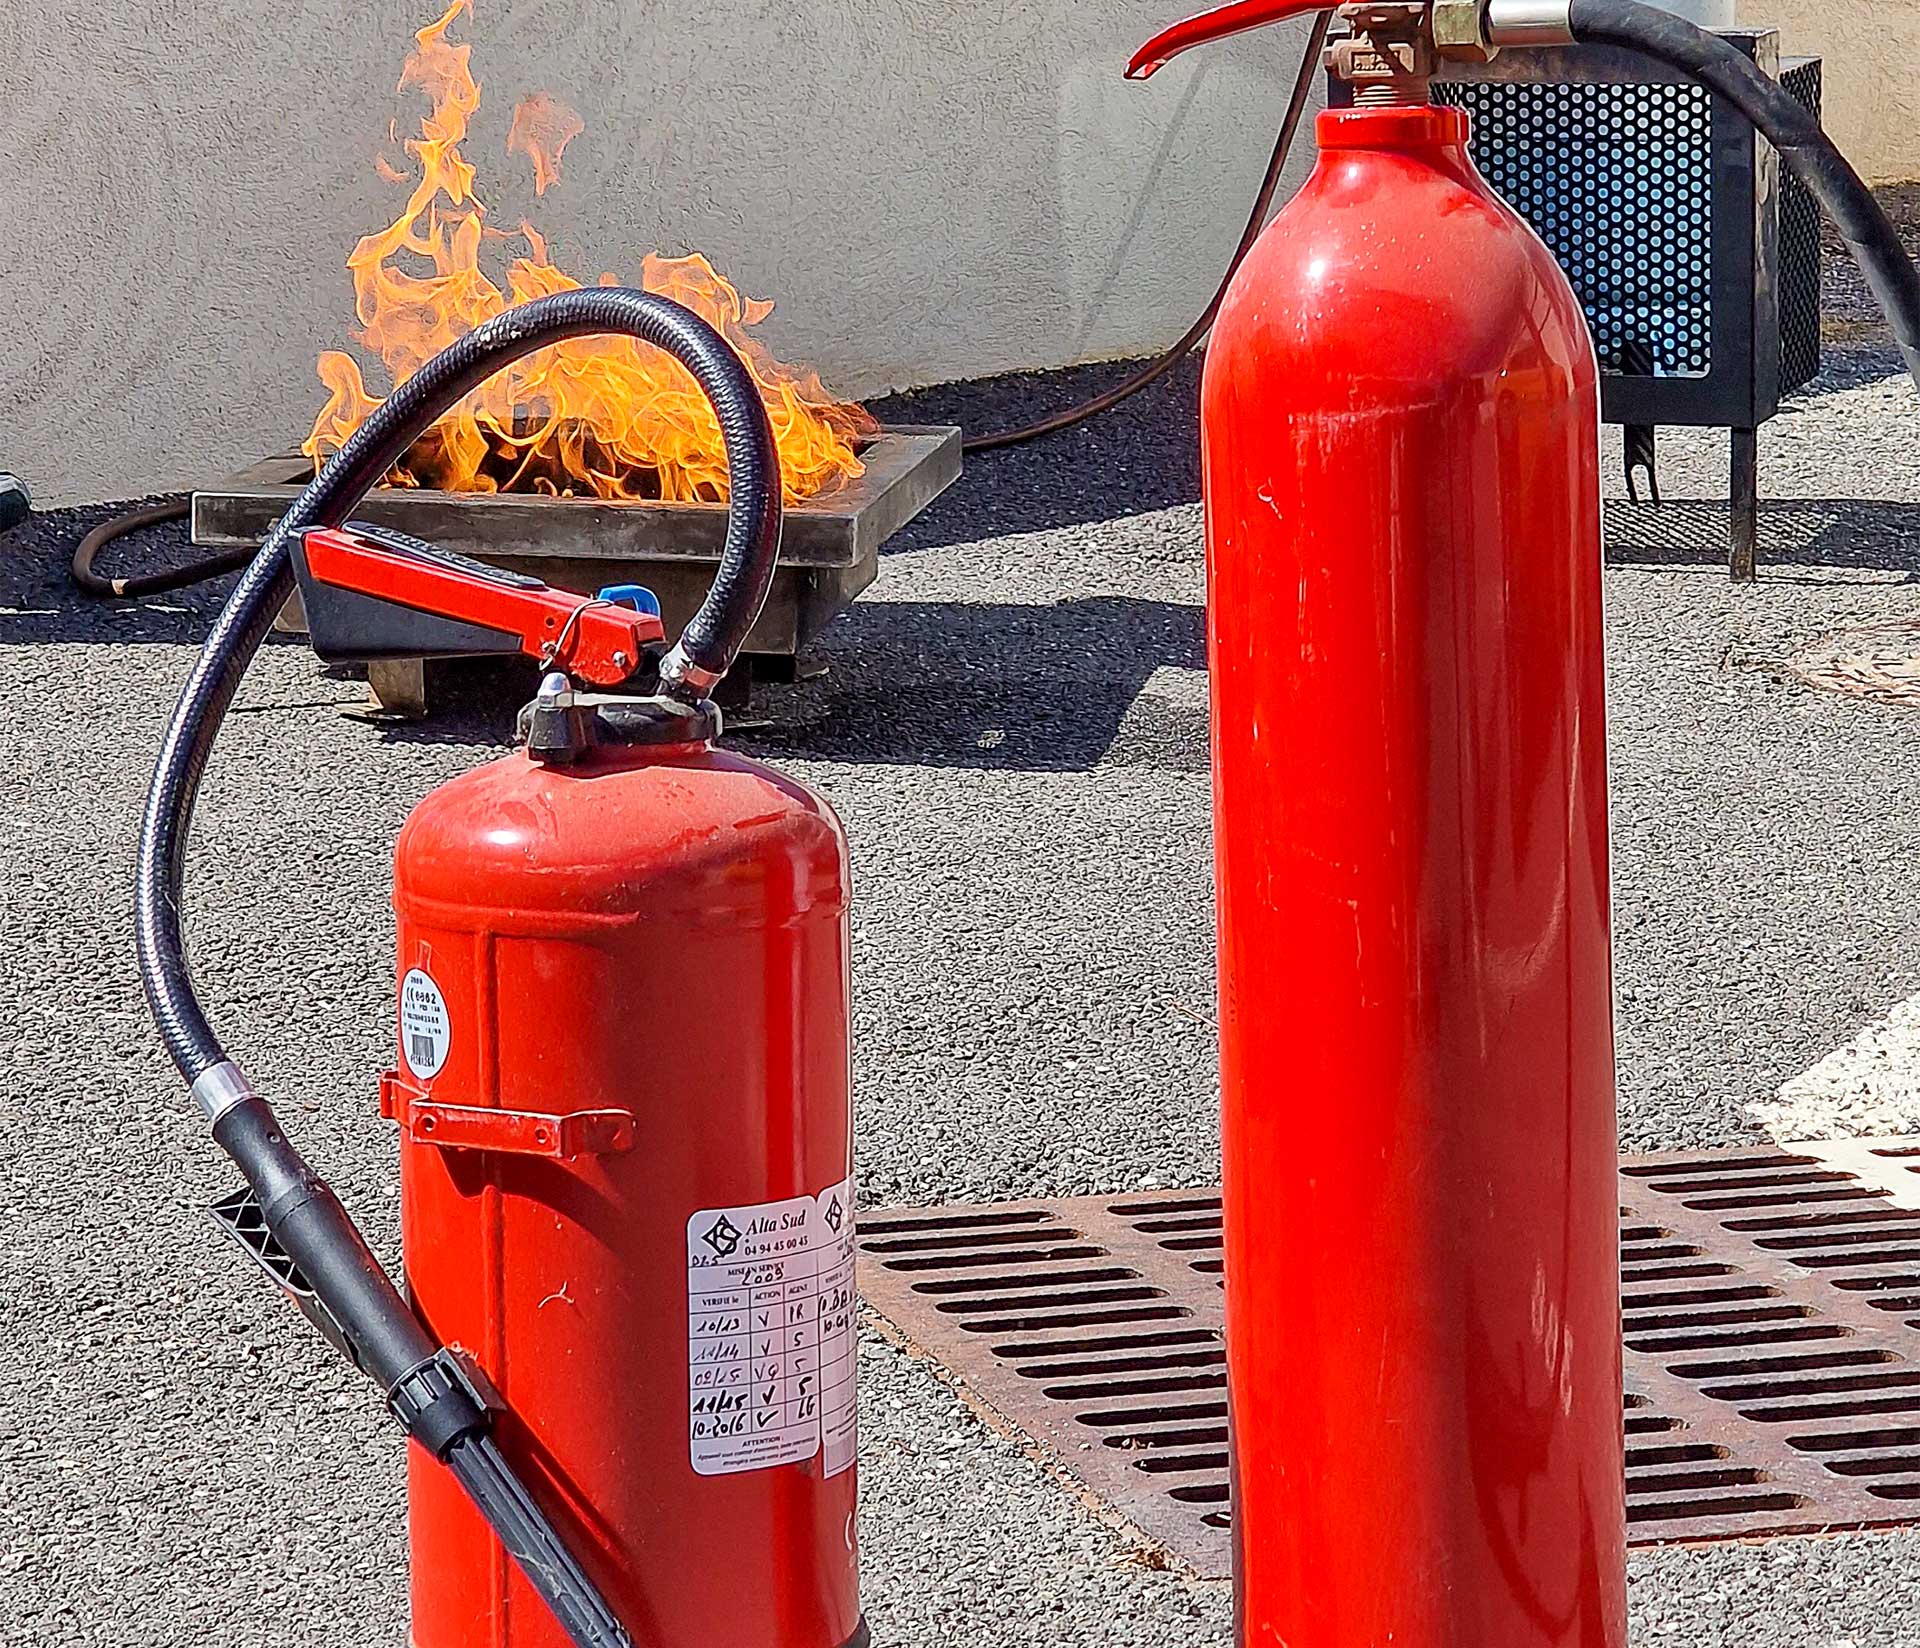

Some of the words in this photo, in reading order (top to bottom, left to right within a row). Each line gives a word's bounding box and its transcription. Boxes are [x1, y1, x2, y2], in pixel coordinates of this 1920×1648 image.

[745, 1217, 777, 1236] Alta
[780, 1209, 807, 1234] Sud
[786, 1238, 797, 1249] 00
[788, 1284, 808, 1294] AGENT
[754, 1290, 781, 1301] ACTION
